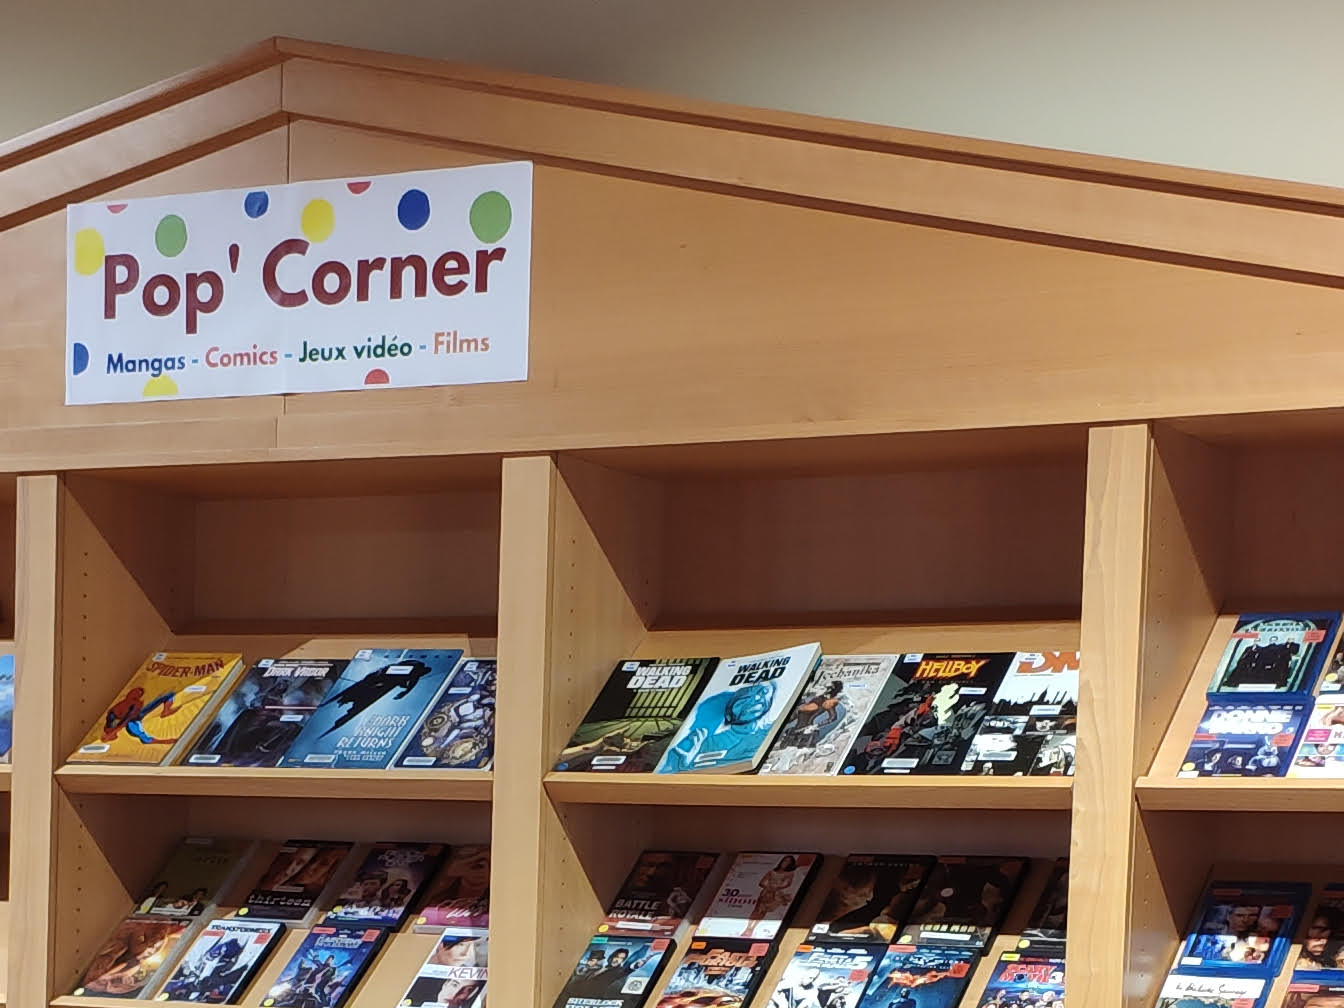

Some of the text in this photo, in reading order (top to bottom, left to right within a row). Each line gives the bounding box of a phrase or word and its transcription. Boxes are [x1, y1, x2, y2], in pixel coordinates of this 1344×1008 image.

[103, 238, 507, 335] Pop' Corner
[106, 330, 490, 377] Mangas Comics Jeux vidéo Films
[145, 659, 225, 680] SPIDER-MAN
[738, 656, 791, 673] WALKING
[915, 659, 989, 679] HELLBOY
[636, 666, 692, 676] WALKING
[729, 666, 787, 686] DEAD
[626, 676, 688, 689] DEAD
[372, 715, 410, 726] DARK
[355, 726, 402, 737] KNIGHT
[336, 737, 394, 748] RETURNS
[722, 888, 739, 897] 30
[615, 900, 659, 909] BATTLE
[609, 910, 655, 920] ROYALE
[211, 924, 273, 934] TRANSFORMERS
[1005, 964, 1058, 973] SCARY
[567, 998, 624, 1006] SHERLOCK
